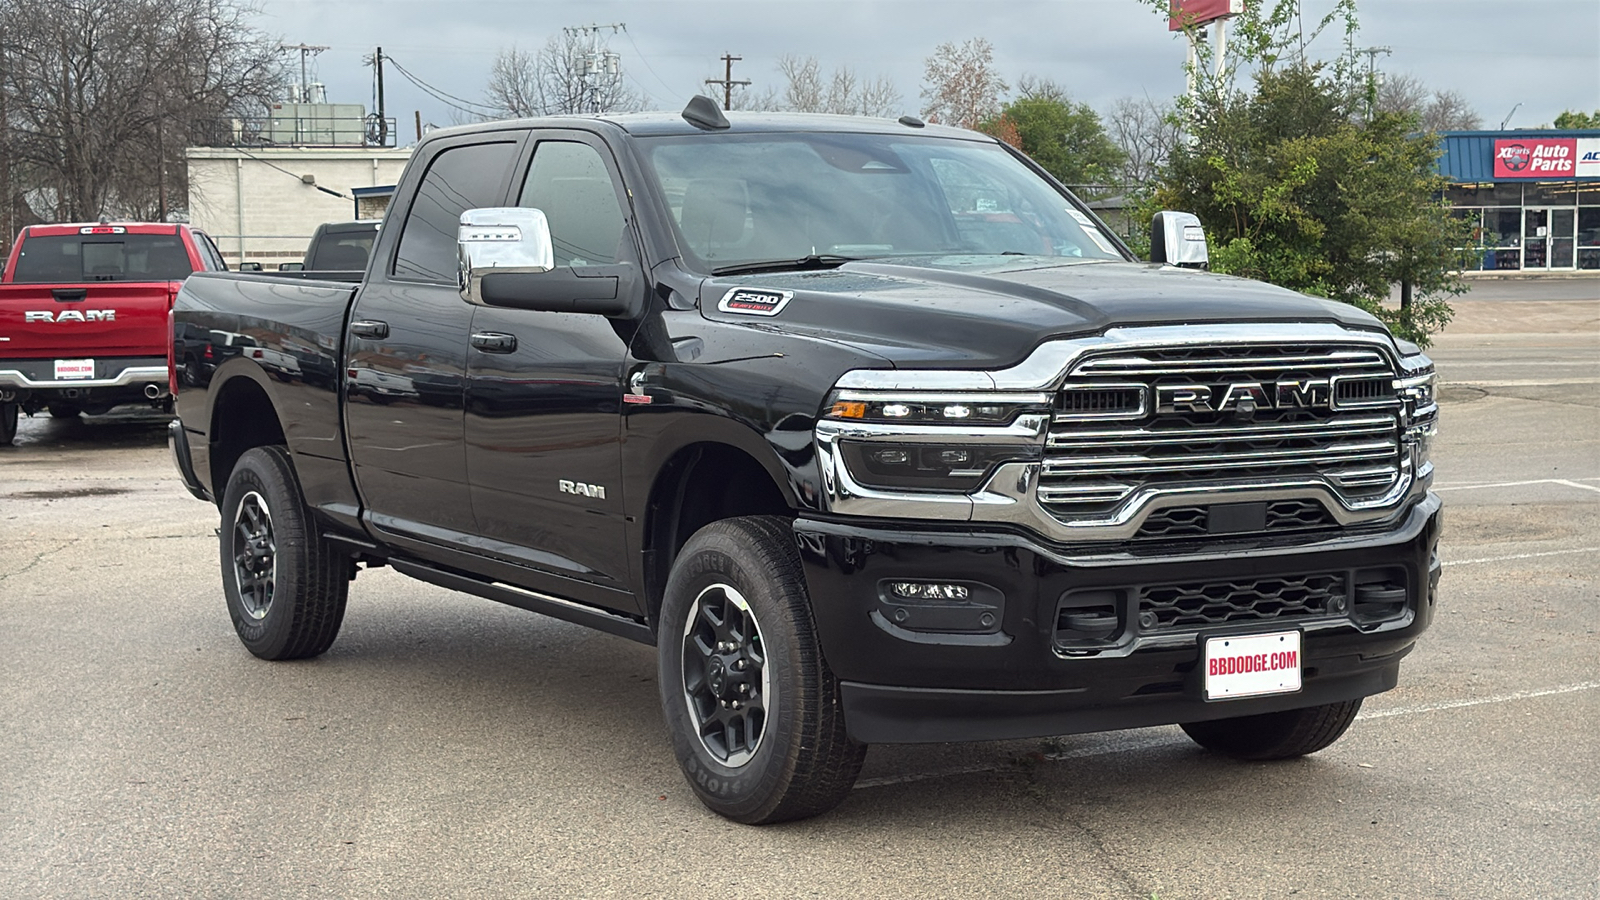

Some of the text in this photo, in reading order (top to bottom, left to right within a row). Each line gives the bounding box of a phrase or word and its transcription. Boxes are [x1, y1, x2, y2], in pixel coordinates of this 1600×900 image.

[1532, 144, 1569, 158] Auto
[1530, 158, 1572, 171] Parts
[734, 292, 779, 304] 2500
[25, 310, 115, 322] RAM
[1156, 380, 1328, 413] RAM
[559, 479, 605, 499] RAM
[1209, 650, 1297, 676] BBDODGE.COM
